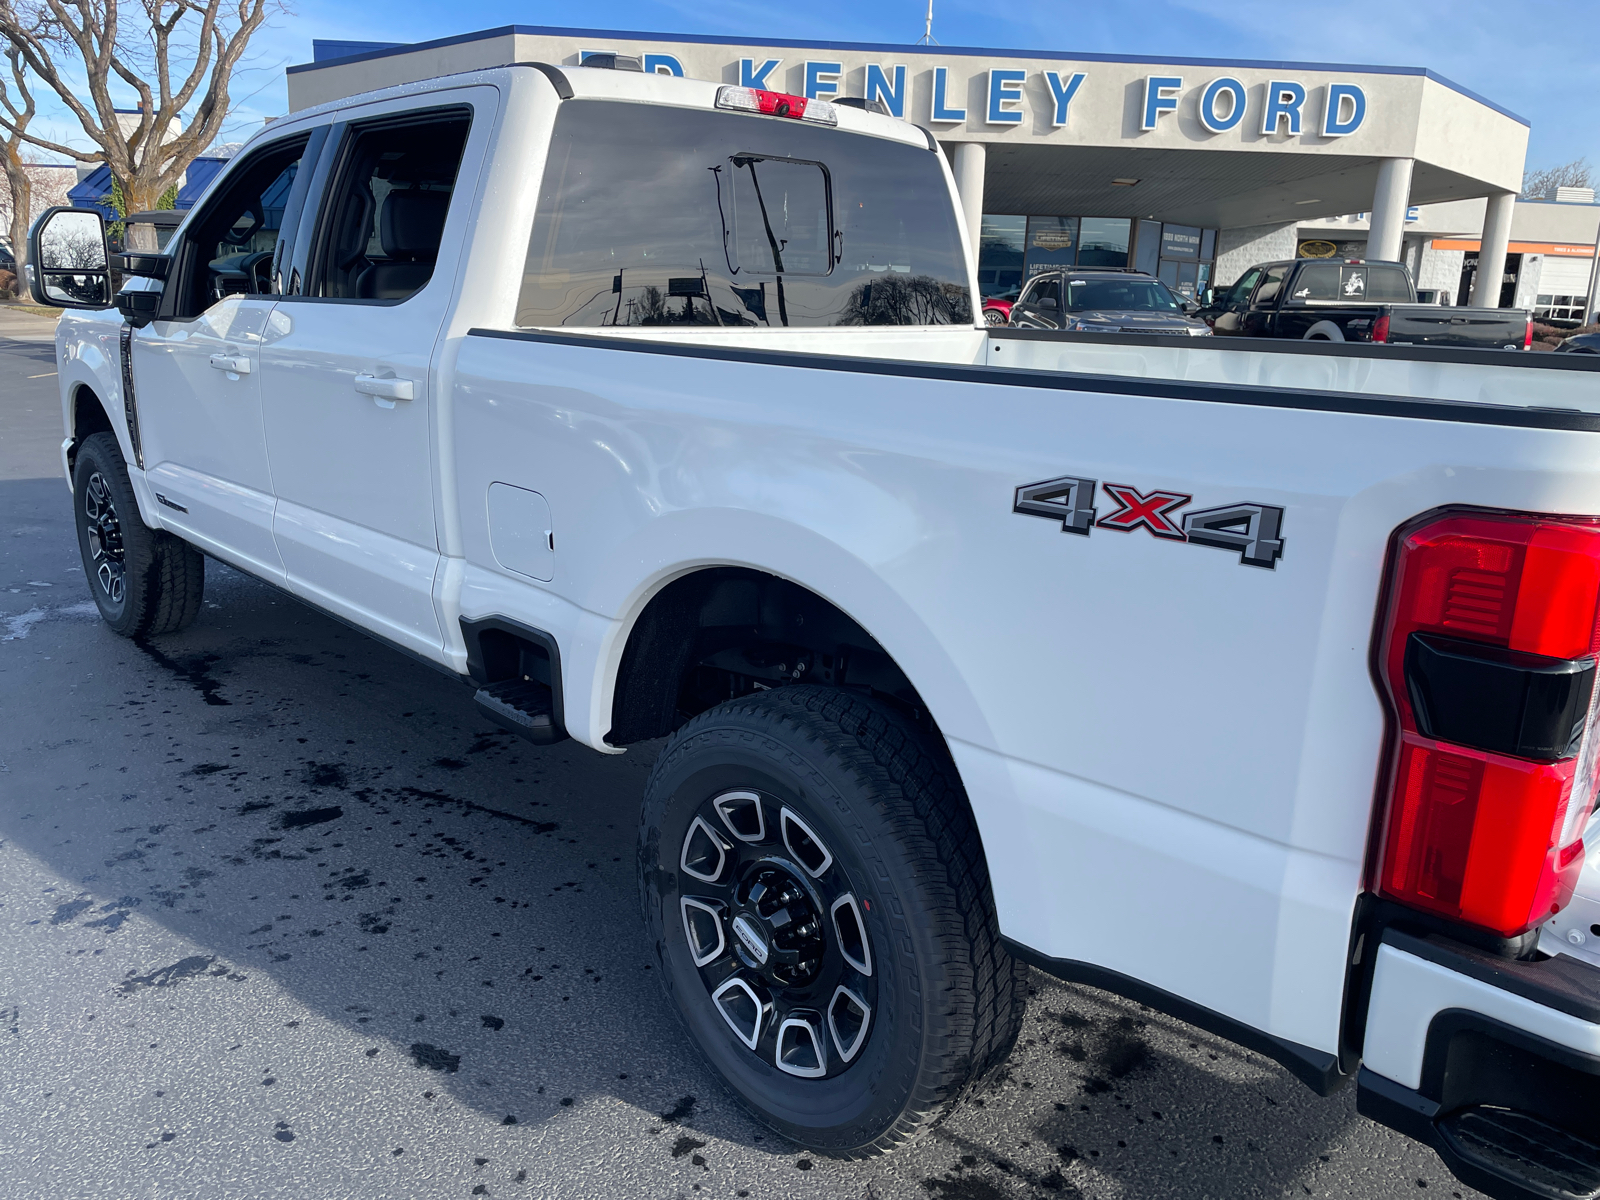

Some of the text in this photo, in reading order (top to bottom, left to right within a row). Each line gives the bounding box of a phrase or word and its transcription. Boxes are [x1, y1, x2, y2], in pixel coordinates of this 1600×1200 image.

[738, 57, 1088, 127] KENLEY
[1140, 75, 1368, 138] FORD
[735, 924, 763, 957] FORD
